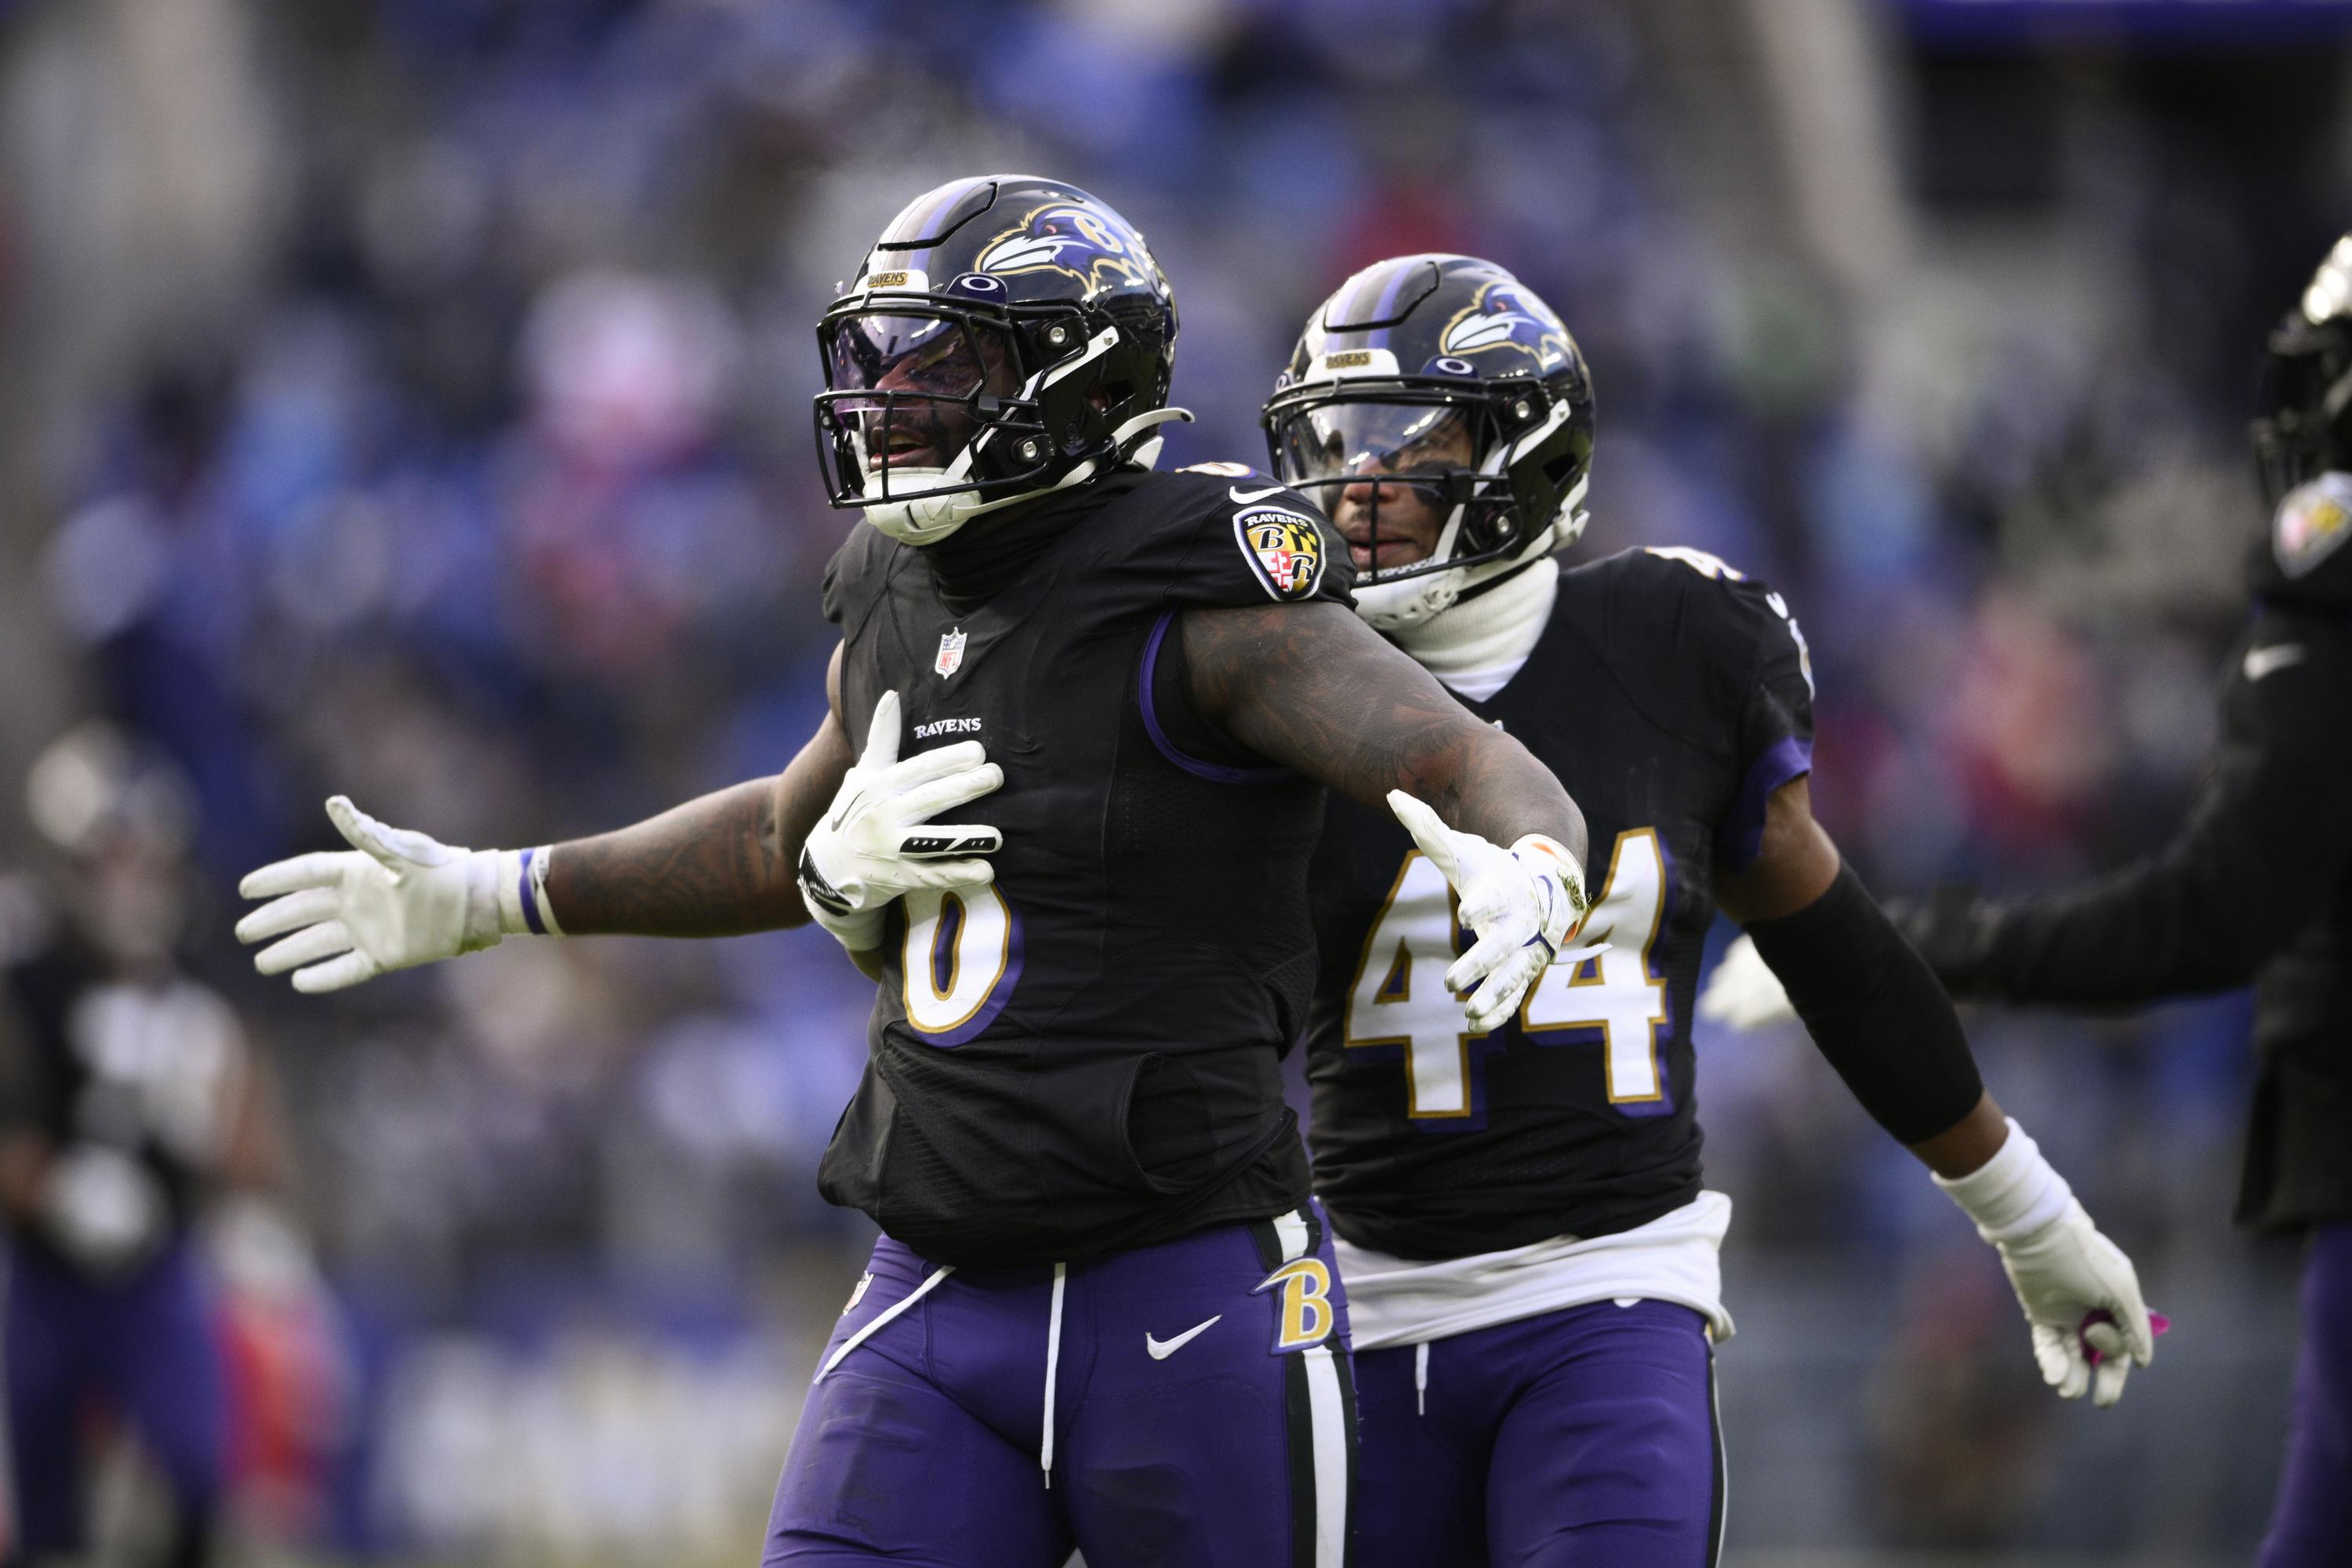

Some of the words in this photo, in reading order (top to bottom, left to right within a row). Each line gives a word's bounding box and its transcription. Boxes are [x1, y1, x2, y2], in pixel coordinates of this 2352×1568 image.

[867, 271, 908, 288] RAVENS
[1244, 514, 1308, 528] RAVENS
[1251, 526, 1286, 550] B
[1289, 553, 1314, 581] R
[941, 652, 958, 668] NFL
[914, 717, 982, 739] RAVENS
[1344, 826, 1670, 1123] 44
[1254, 1258, 1334, 1348] B
